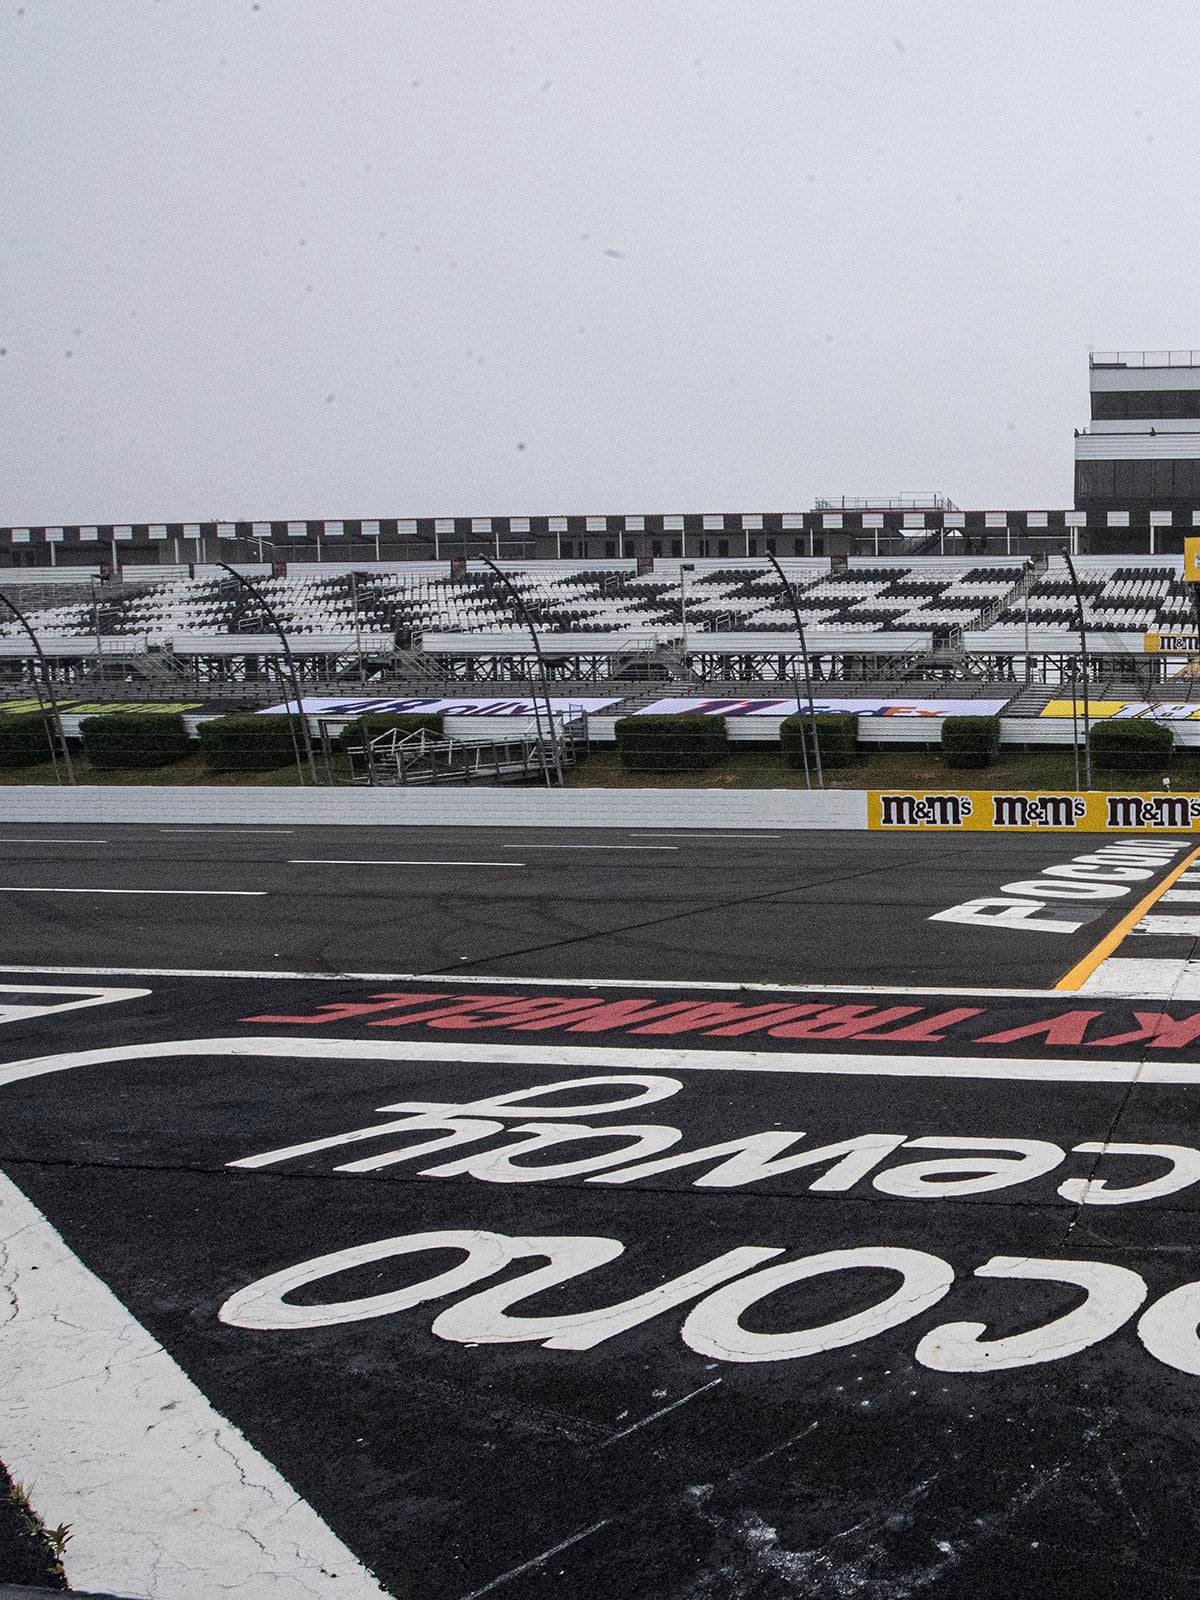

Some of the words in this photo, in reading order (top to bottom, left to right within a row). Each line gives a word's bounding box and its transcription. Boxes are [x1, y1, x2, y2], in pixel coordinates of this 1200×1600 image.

[1159, 635, 1200, 650] m&m
[1111, 703, 1200, 719] 18
[927, 839, 1193, 935] POCONO
[238, 992, 984, 1043] TRIANGLE
